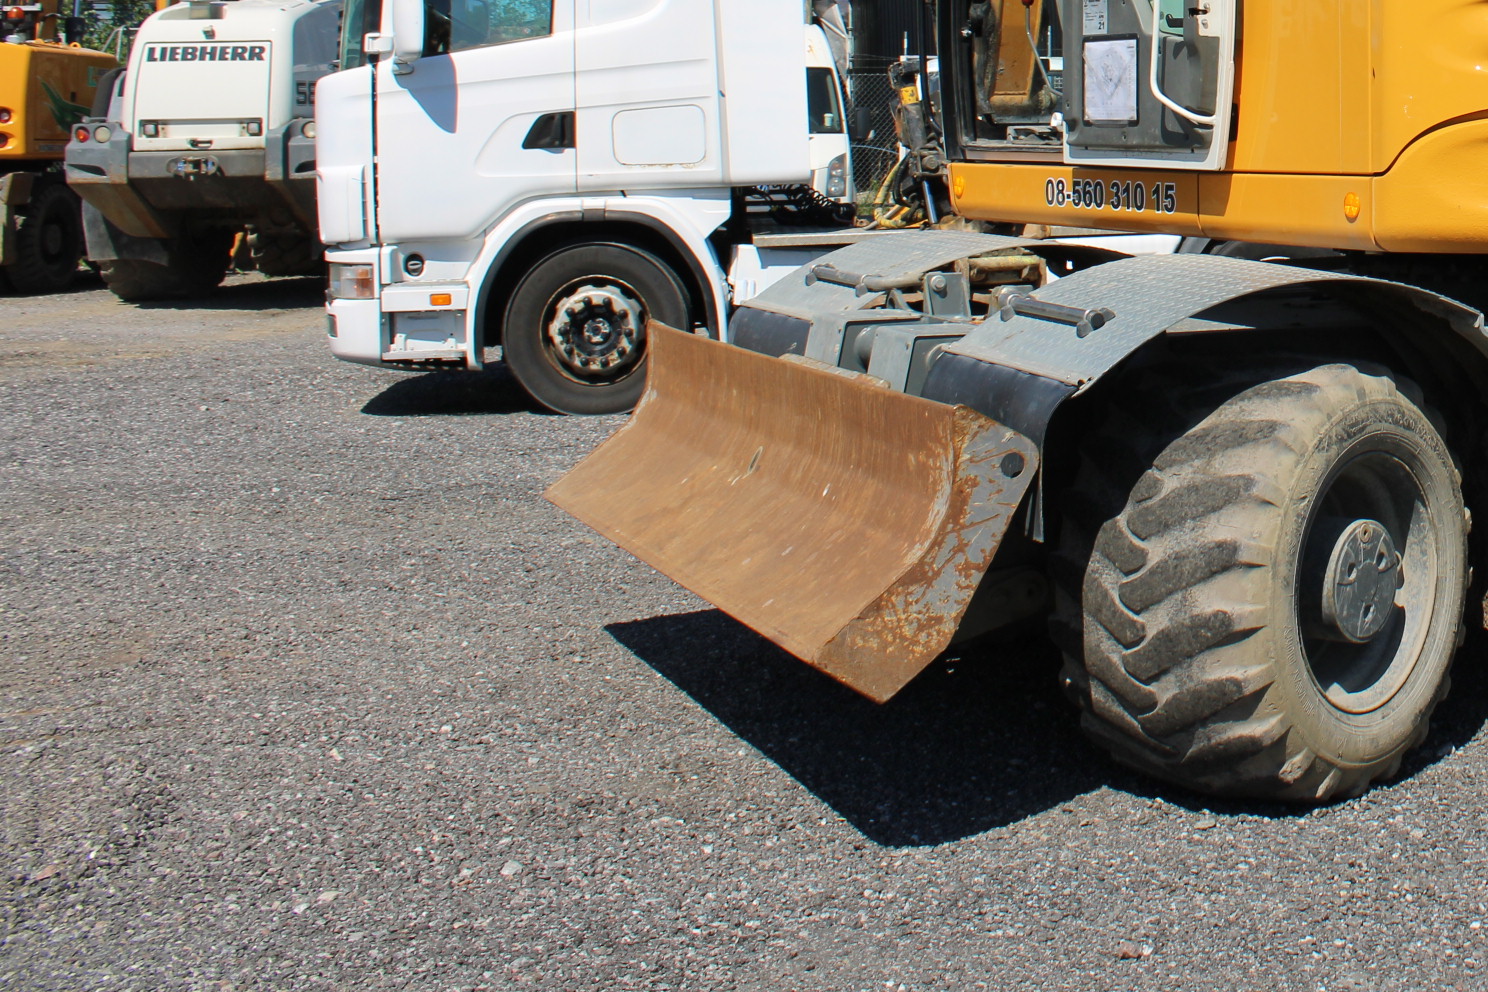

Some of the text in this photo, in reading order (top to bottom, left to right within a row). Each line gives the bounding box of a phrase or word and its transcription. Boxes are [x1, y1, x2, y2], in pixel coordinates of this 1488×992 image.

[146, 46, 266, 62] LIEBHERR
[1046, 178, 1176, 214] 08-560 310 15
